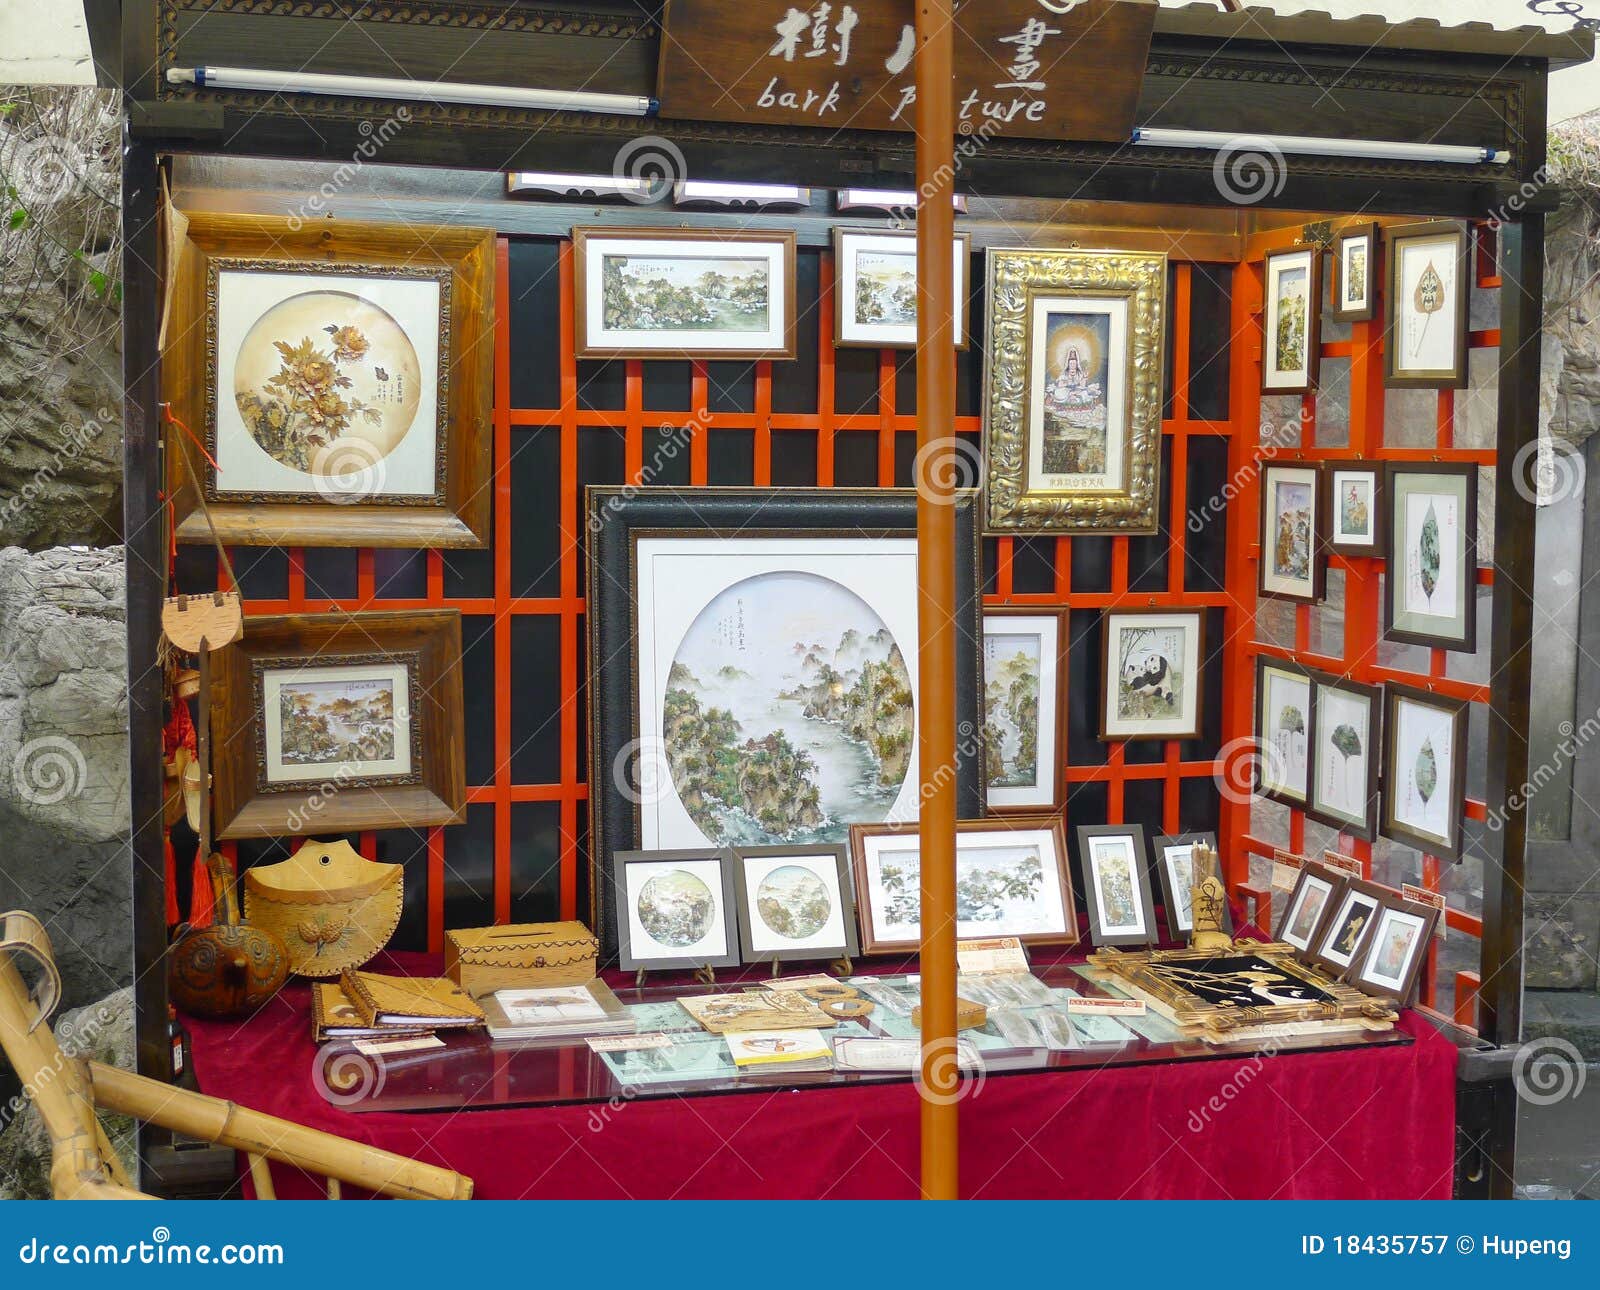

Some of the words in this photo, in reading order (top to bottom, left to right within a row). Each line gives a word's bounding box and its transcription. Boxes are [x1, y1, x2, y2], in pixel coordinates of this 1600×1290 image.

[769, 2, 1063, 91] 樹畫
[755, 76, 841, 117] bark
[888, 84, 1047, 123] pture
